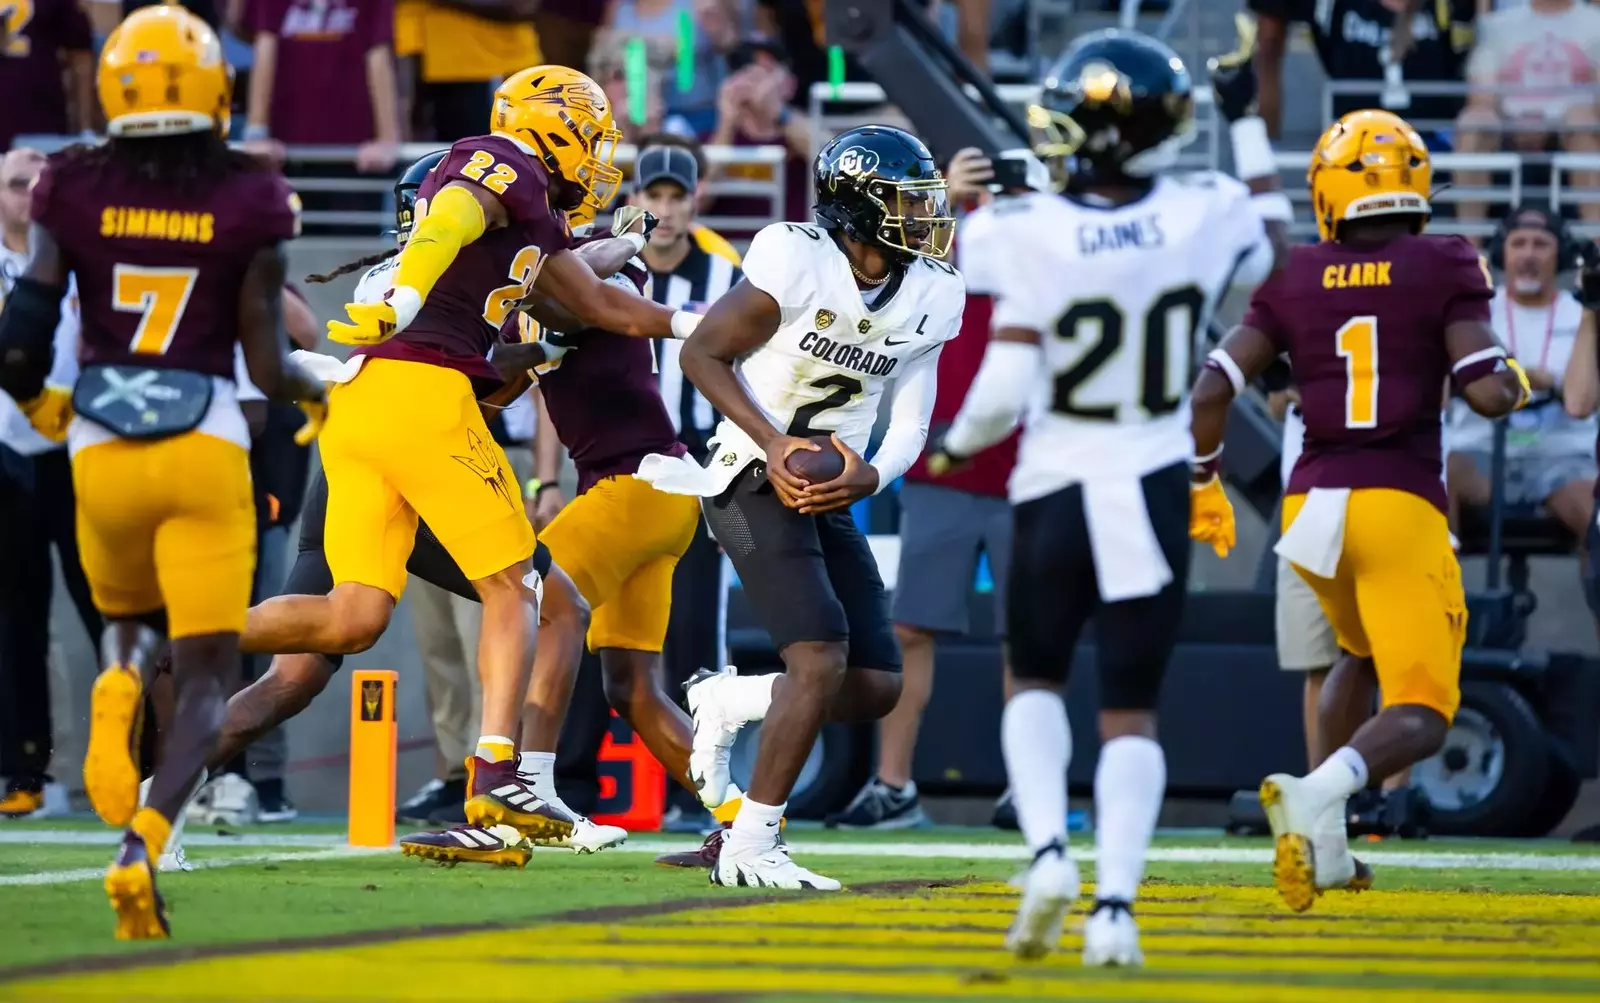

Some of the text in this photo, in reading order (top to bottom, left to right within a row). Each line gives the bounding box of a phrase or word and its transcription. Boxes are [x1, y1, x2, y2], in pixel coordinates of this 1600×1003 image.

[460, 150, 518, 195] 22
[100, 206, 215, 243] SIMMONS
[1077, 214, 1166, 256] GAINES
[1321, 261, 1393, 289] CLARK
[112, 262, 200, 356] 7
[915, 313, 929, 336] L
[798, 331, 899, 377] COLORADO
[1051, 282, 1205, 421] 20
[1335, 315, 1380, 429] 1
[786, 373, 863, 438] 2
